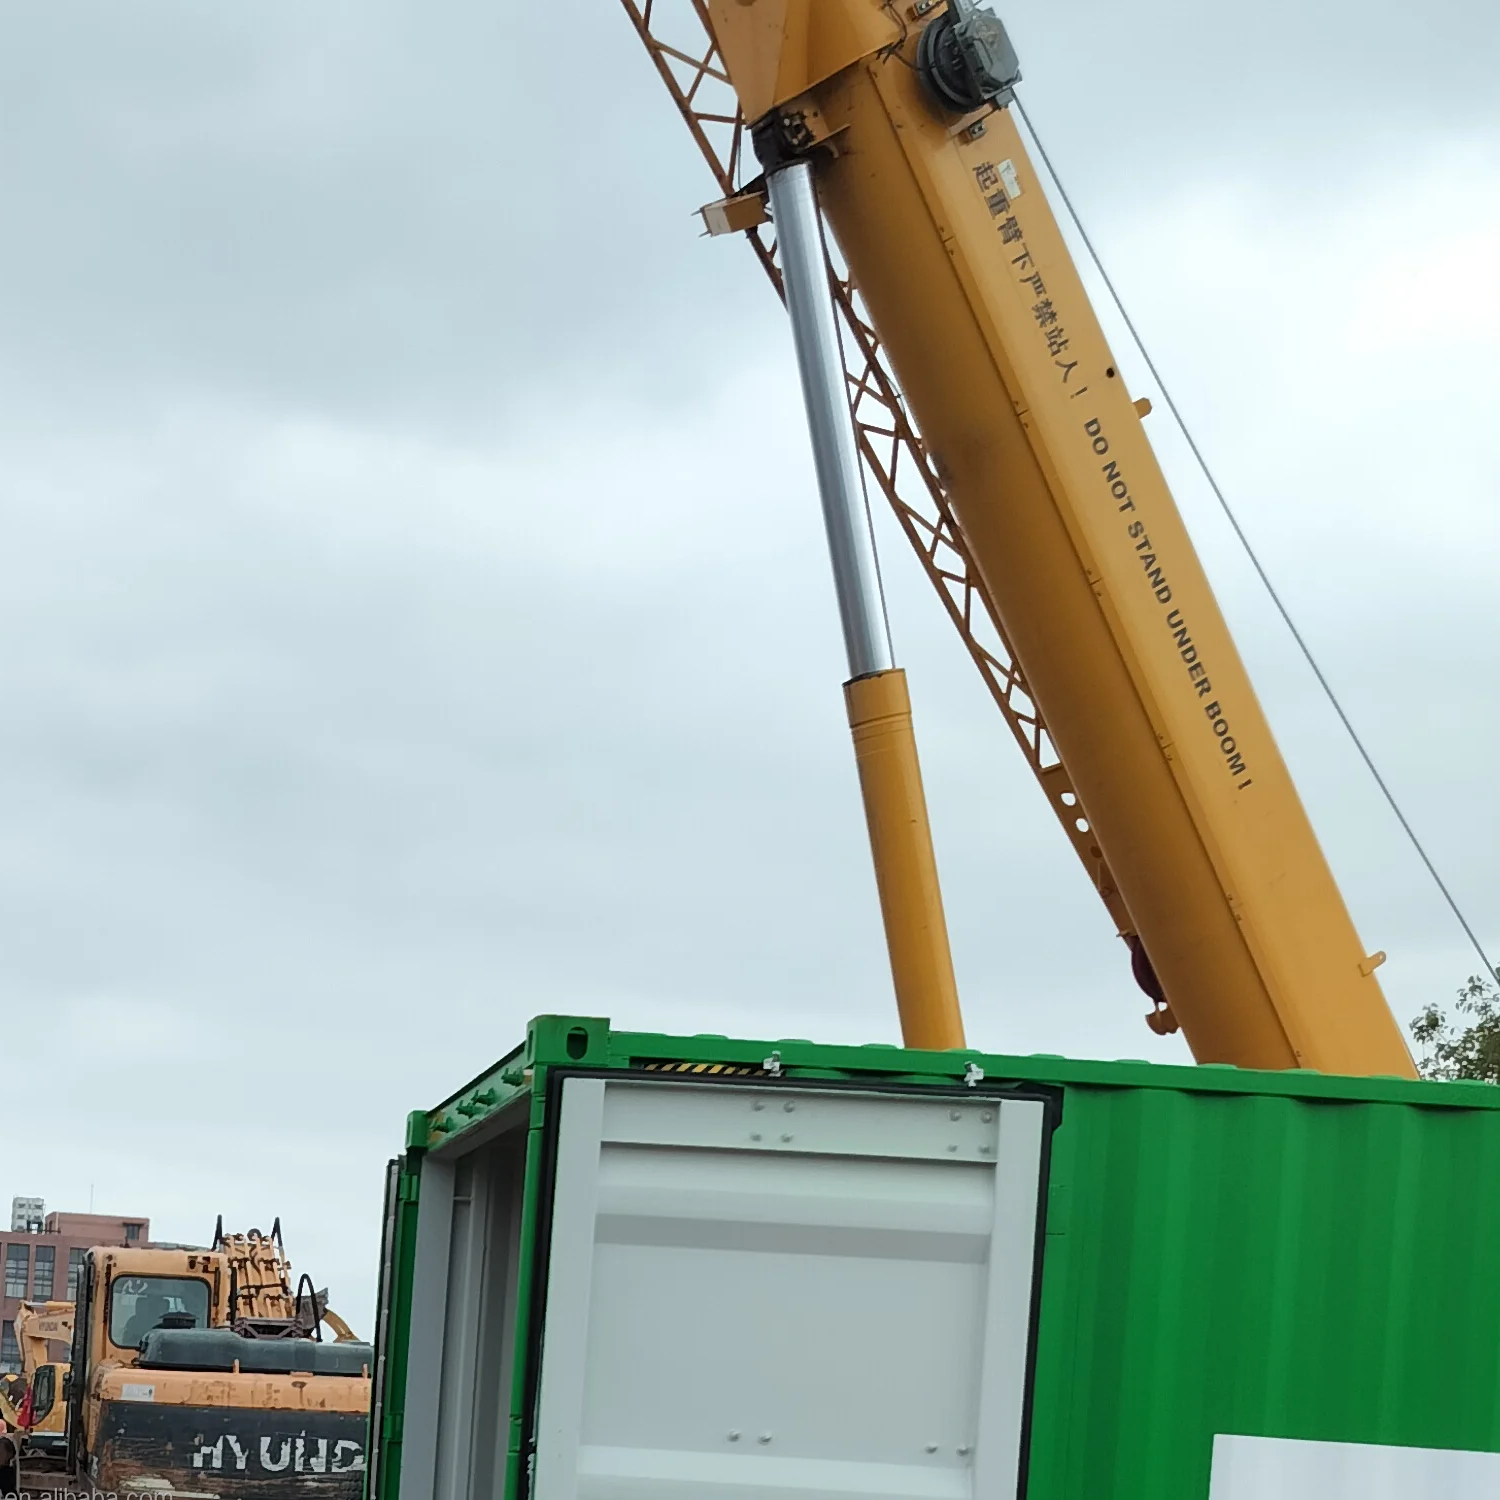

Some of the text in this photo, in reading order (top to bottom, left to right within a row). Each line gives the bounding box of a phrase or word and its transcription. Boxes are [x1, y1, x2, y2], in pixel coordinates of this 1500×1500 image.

[1083, 417, 1109, 456] DO
[1101, 460, 1136, 513] NOT
[1127, 520, 1172, 604] STAND
[1166, 609, 1212, 698] UNDER
